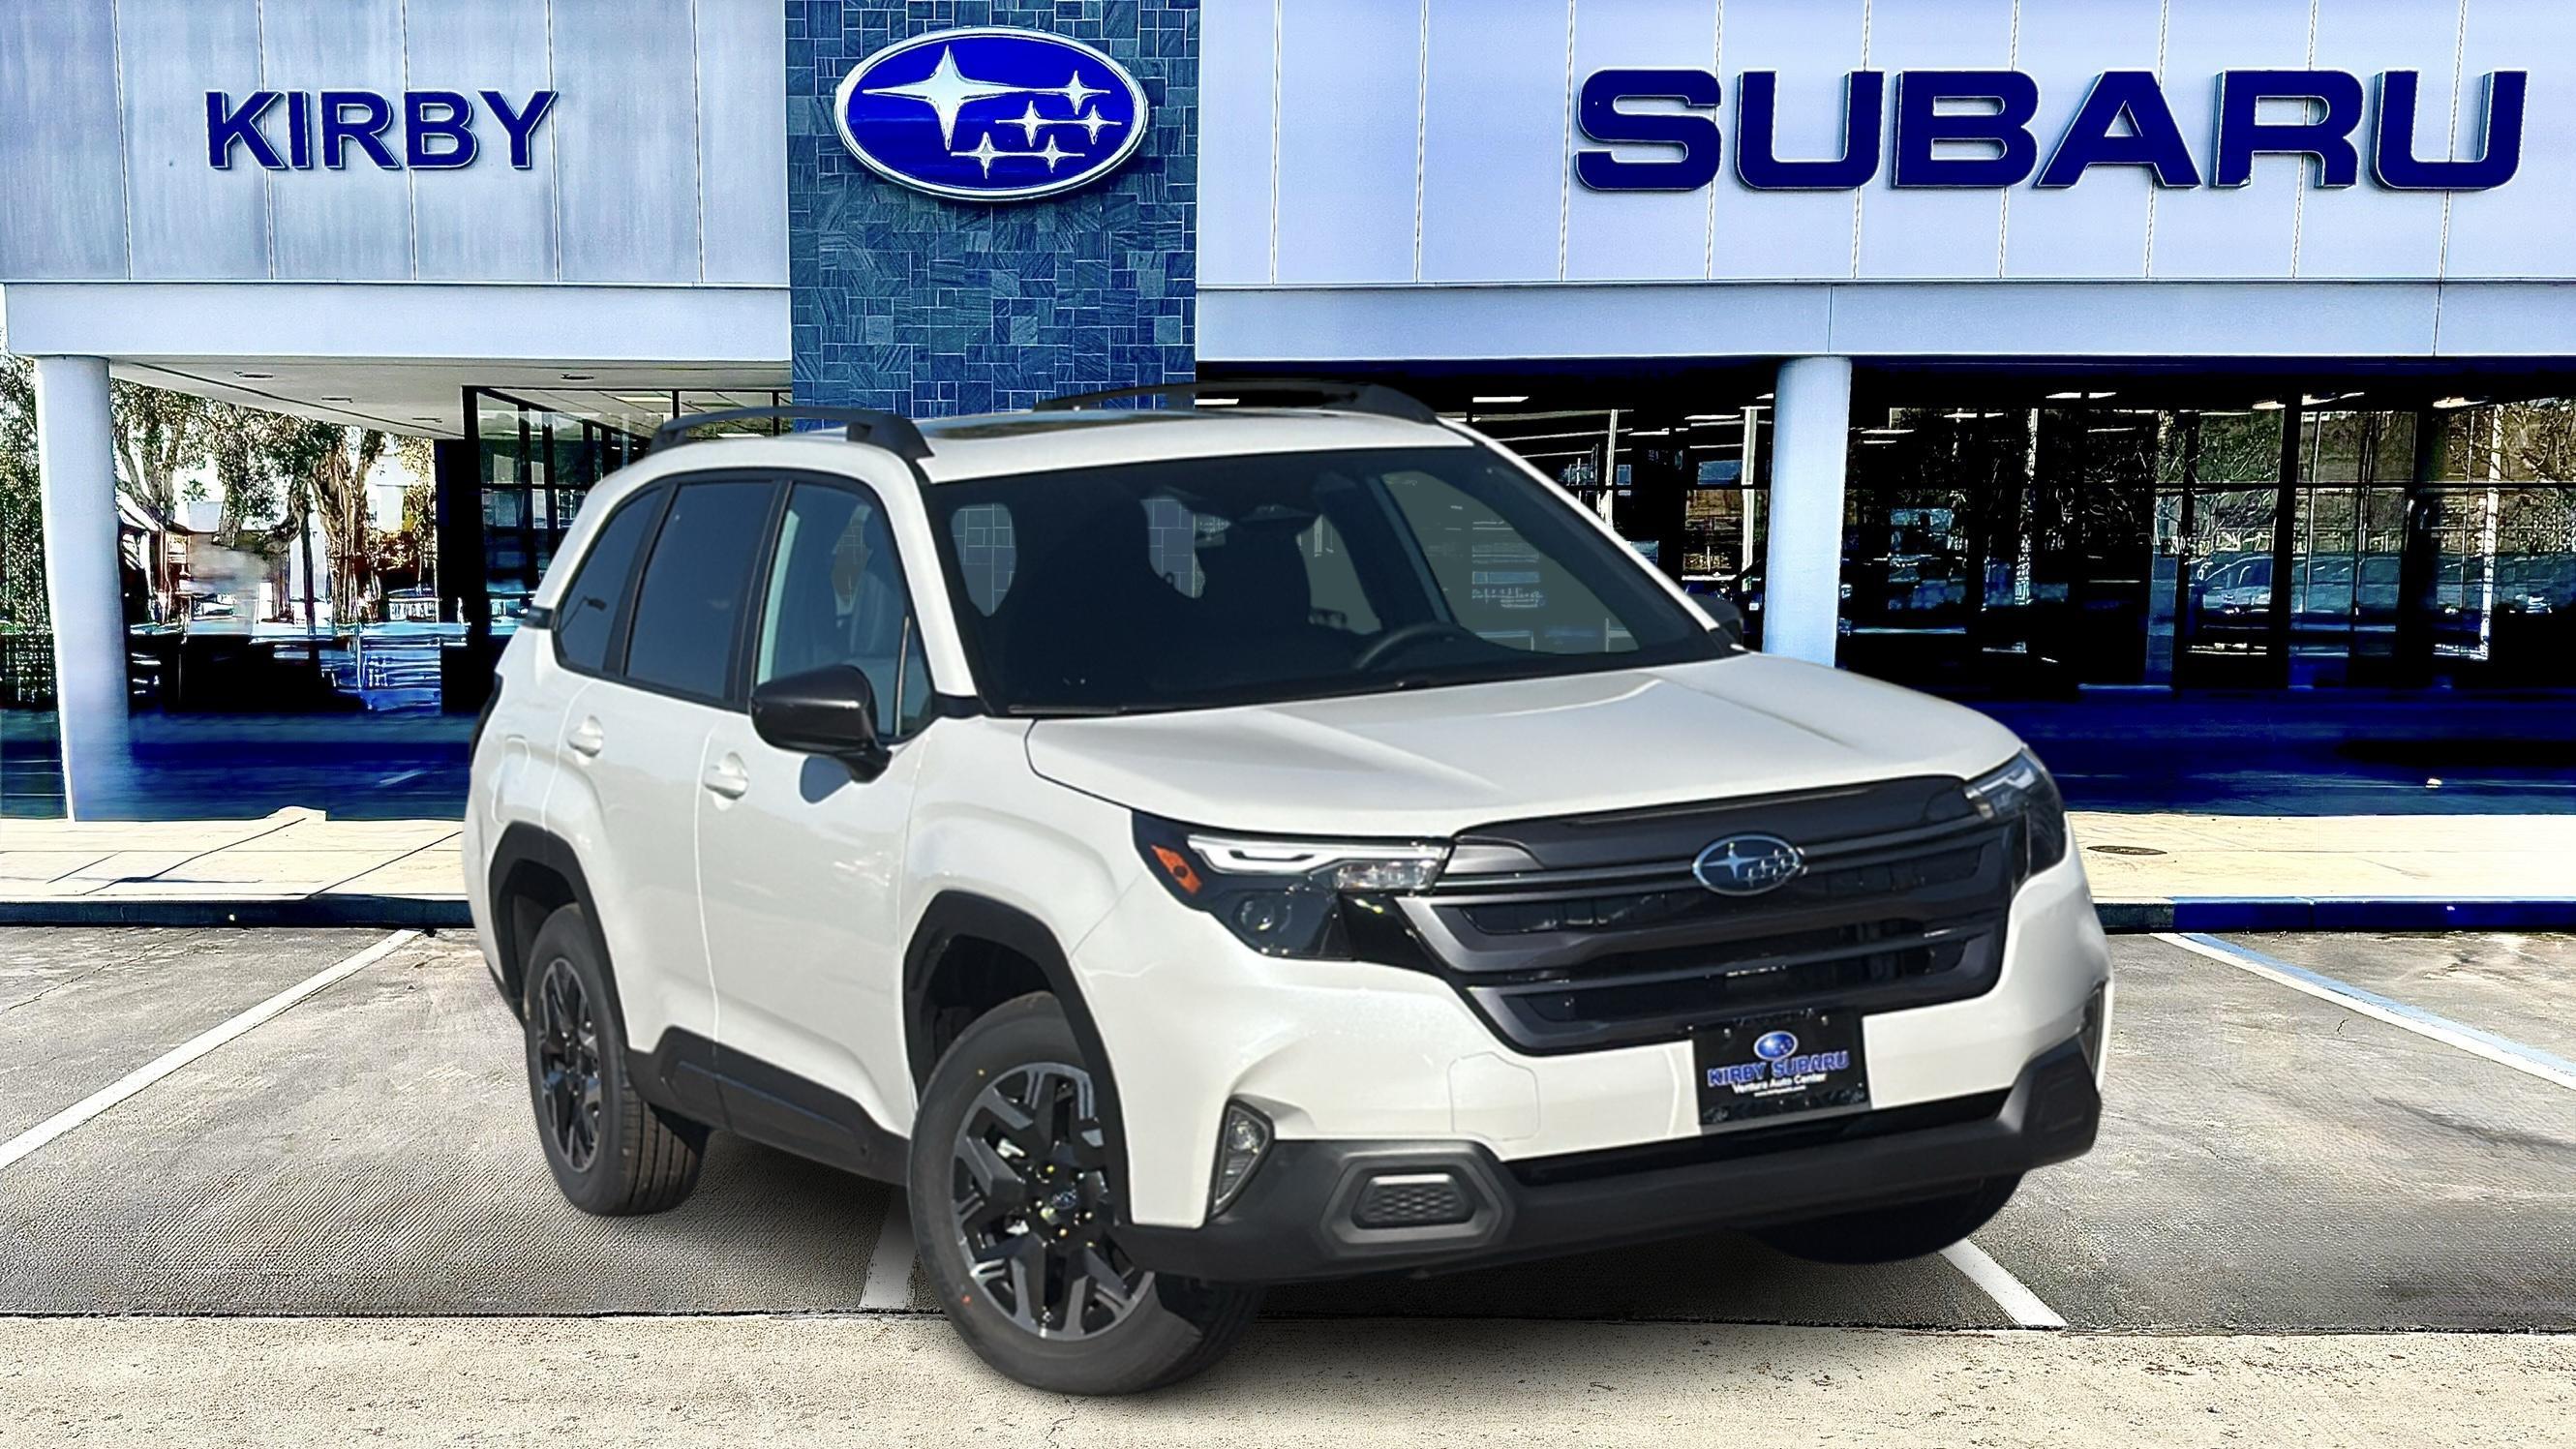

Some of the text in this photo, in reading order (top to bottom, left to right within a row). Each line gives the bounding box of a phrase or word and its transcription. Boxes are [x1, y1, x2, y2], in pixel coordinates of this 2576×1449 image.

[205, 90, 559, 170] KIRBY
[1575, 68, 2528, 191] SUBARU
[1707, 1050, 1849, 1087] KIRBY SUBARU
[1769, 1076, 1793, 1088] Auto
[1793, 1072, 1828, 1085] Center
